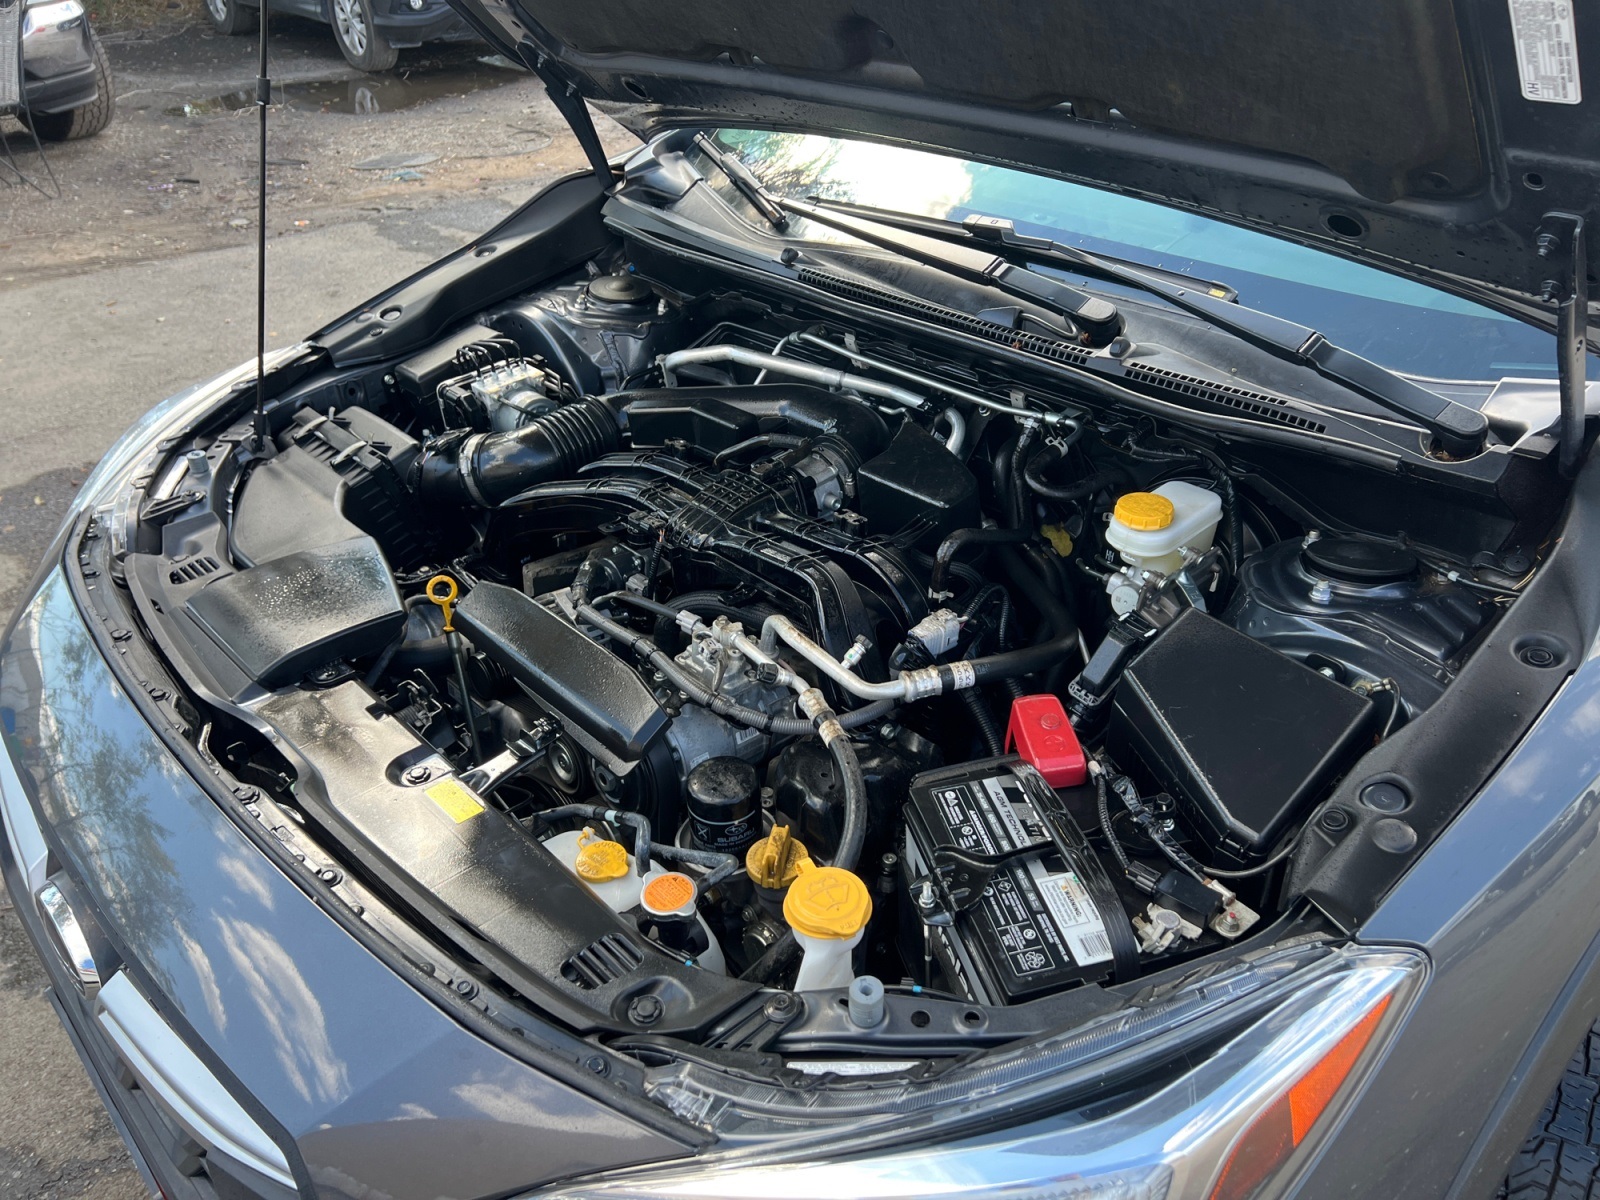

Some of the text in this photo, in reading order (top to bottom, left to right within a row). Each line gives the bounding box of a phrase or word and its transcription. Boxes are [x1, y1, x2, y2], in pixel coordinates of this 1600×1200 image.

[1527, 82, 1540, 96] HV
[994, 790, 1007, 808] AGM
[1004, 810, 1027, 846] TECHNOL
[1019, 808, 1043, 842] PLATIN
[717, 827, 755, 843] SUBARU
[1016, 869, 1026, 879] 100
